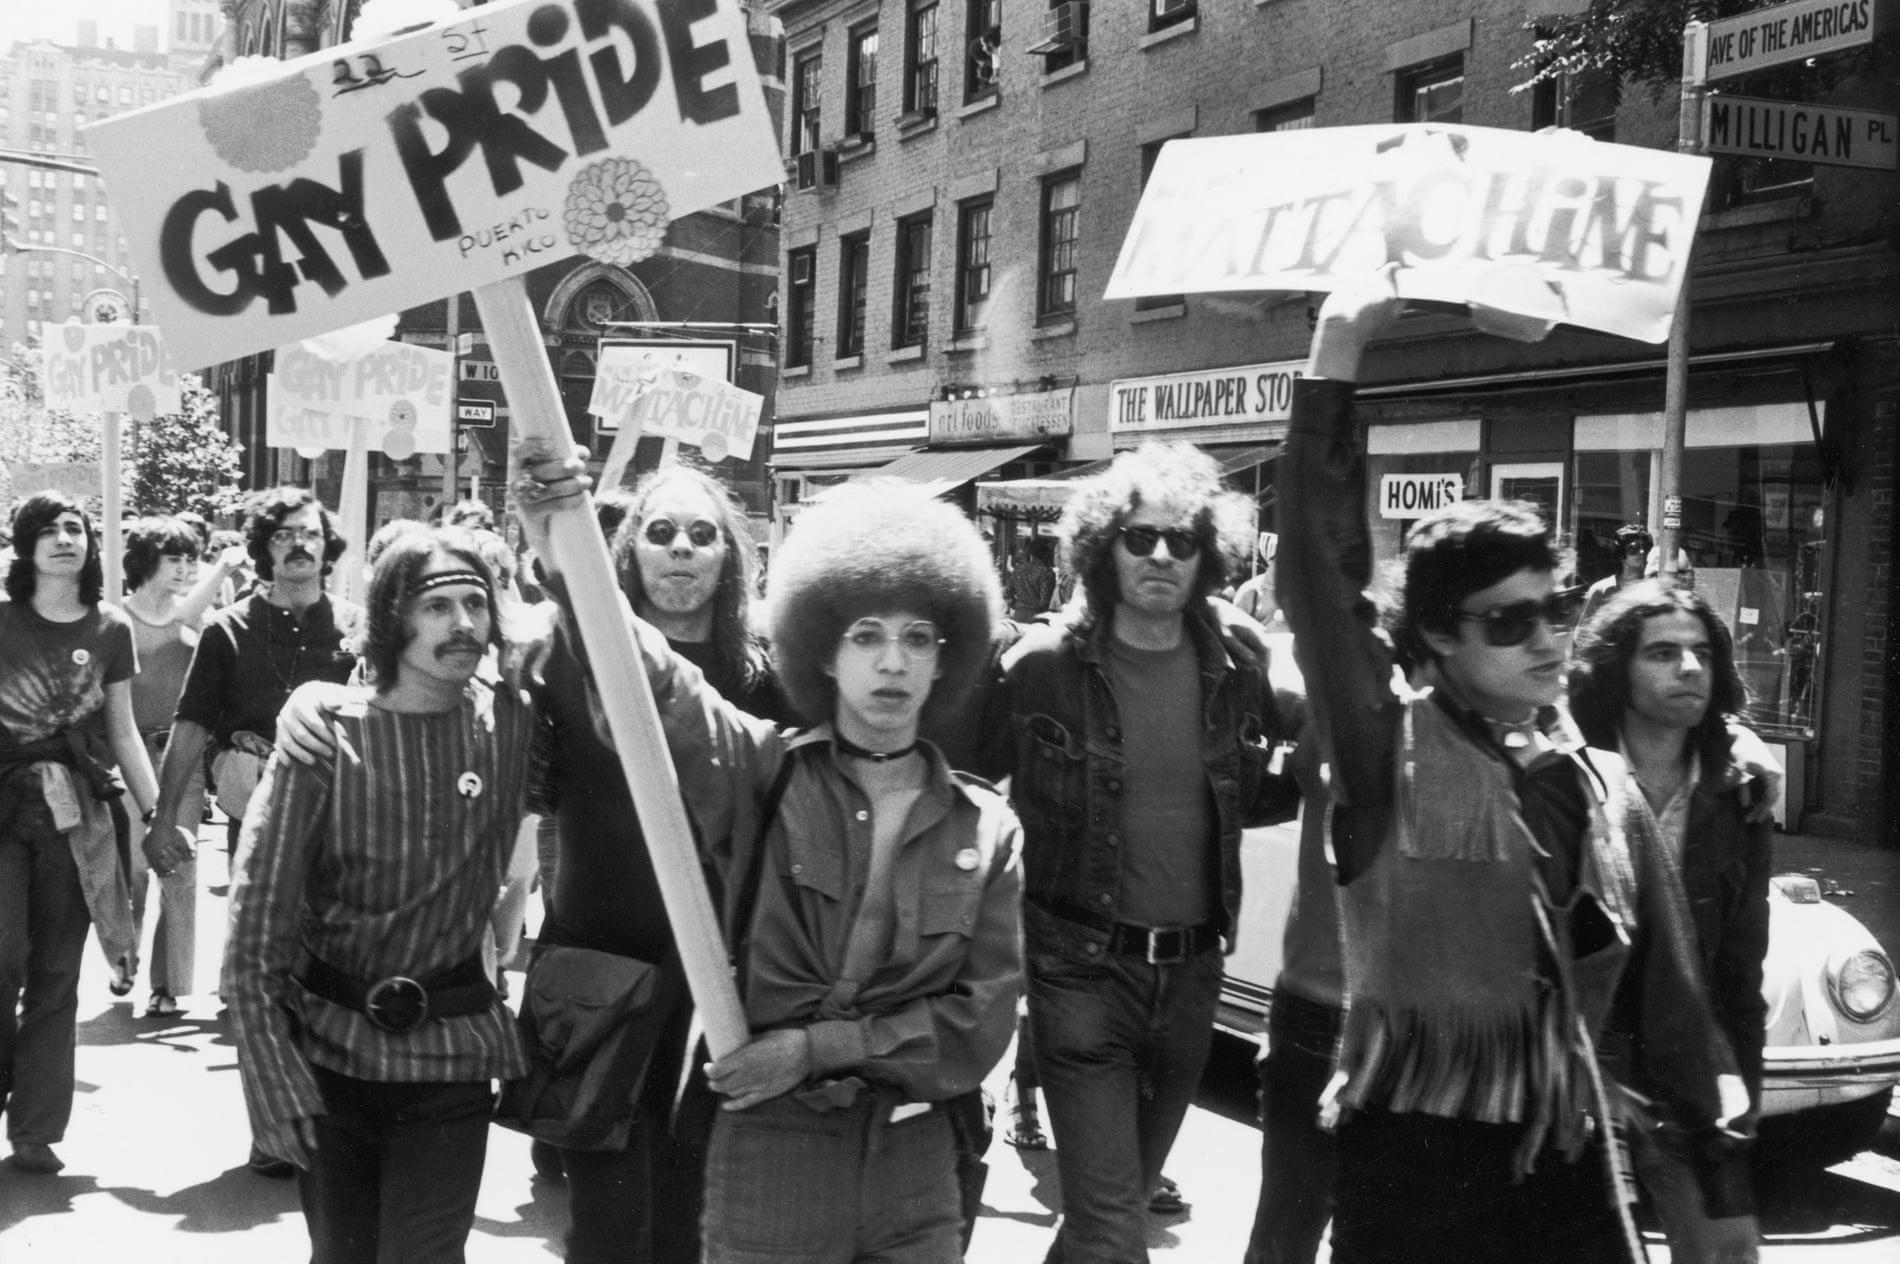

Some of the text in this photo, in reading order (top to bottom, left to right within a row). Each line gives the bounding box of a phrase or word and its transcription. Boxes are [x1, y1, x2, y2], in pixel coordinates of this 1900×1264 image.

[1709, 1, 1869, 67] AVE OF THE AMERICAS
[1710, 102, 1892, 159] MILLIGAN PL
[160, 147, 391, 317] GAY
[459, 207, 550, 259] PUERTO
[503, 234, 556, 266] RICO
[278, 349, 349, 401] GAY
[465, 364, 478, 379] W
[1117, 370, 1303, 424] THE WALLPAPER STO
[464, 407, 488, 418] WAY
